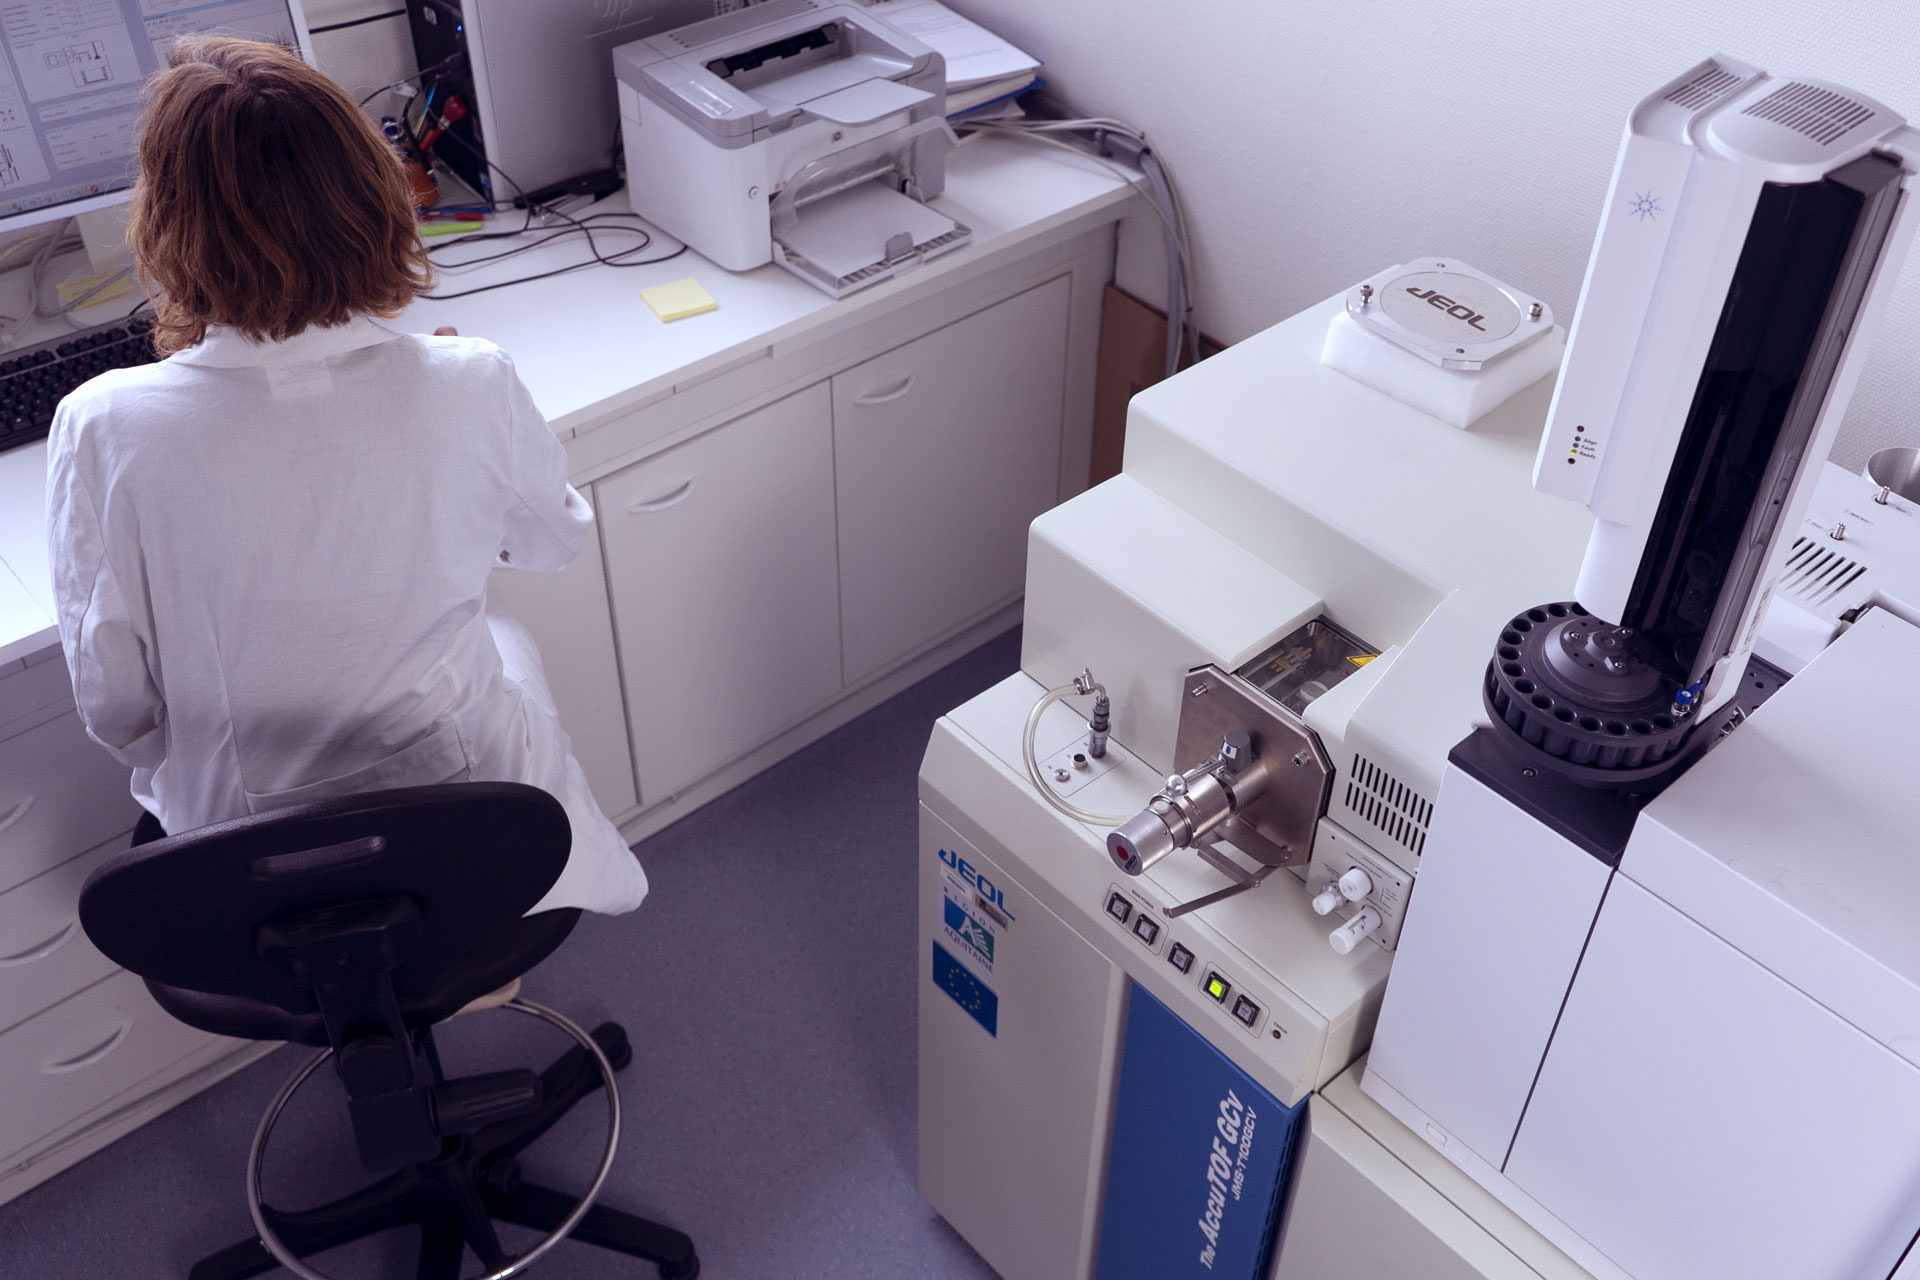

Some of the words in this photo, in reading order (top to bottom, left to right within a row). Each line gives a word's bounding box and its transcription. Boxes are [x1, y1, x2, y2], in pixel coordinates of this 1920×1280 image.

[1406, 287, 1486, 332] JEOL
[1579, 451, 1596, 459] Ready
[938, 849, 1015, 921] JEOL
[944, 926, 993, 974] AQUITAINE
[1200, 1244, 1216, 1270] The
